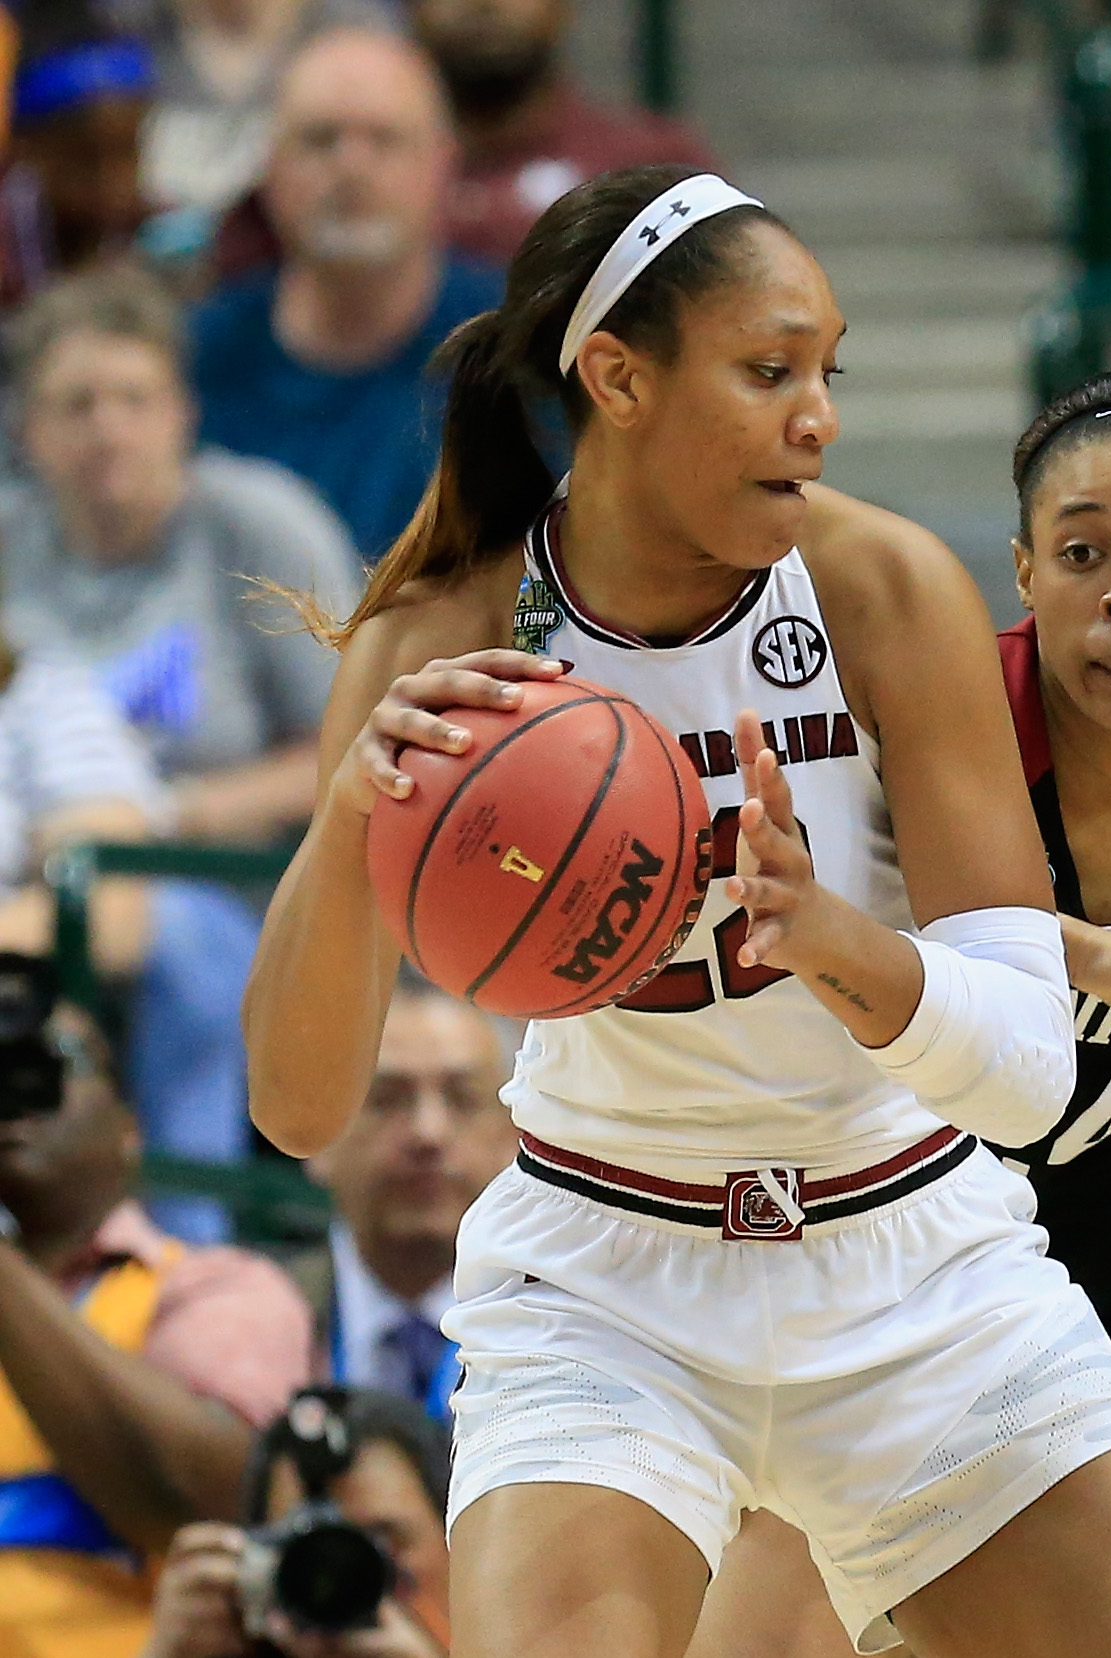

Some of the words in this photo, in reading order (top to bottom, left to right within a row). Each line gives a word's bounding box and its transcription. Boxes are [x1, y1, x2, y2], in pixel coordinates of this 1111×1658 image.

[523, 611, 556, 627] FOUR
[758, 621, 821, 683] SEC
[679, 713, 859, 777] ARLINA
[552, 838, 664, 985] NCAA
